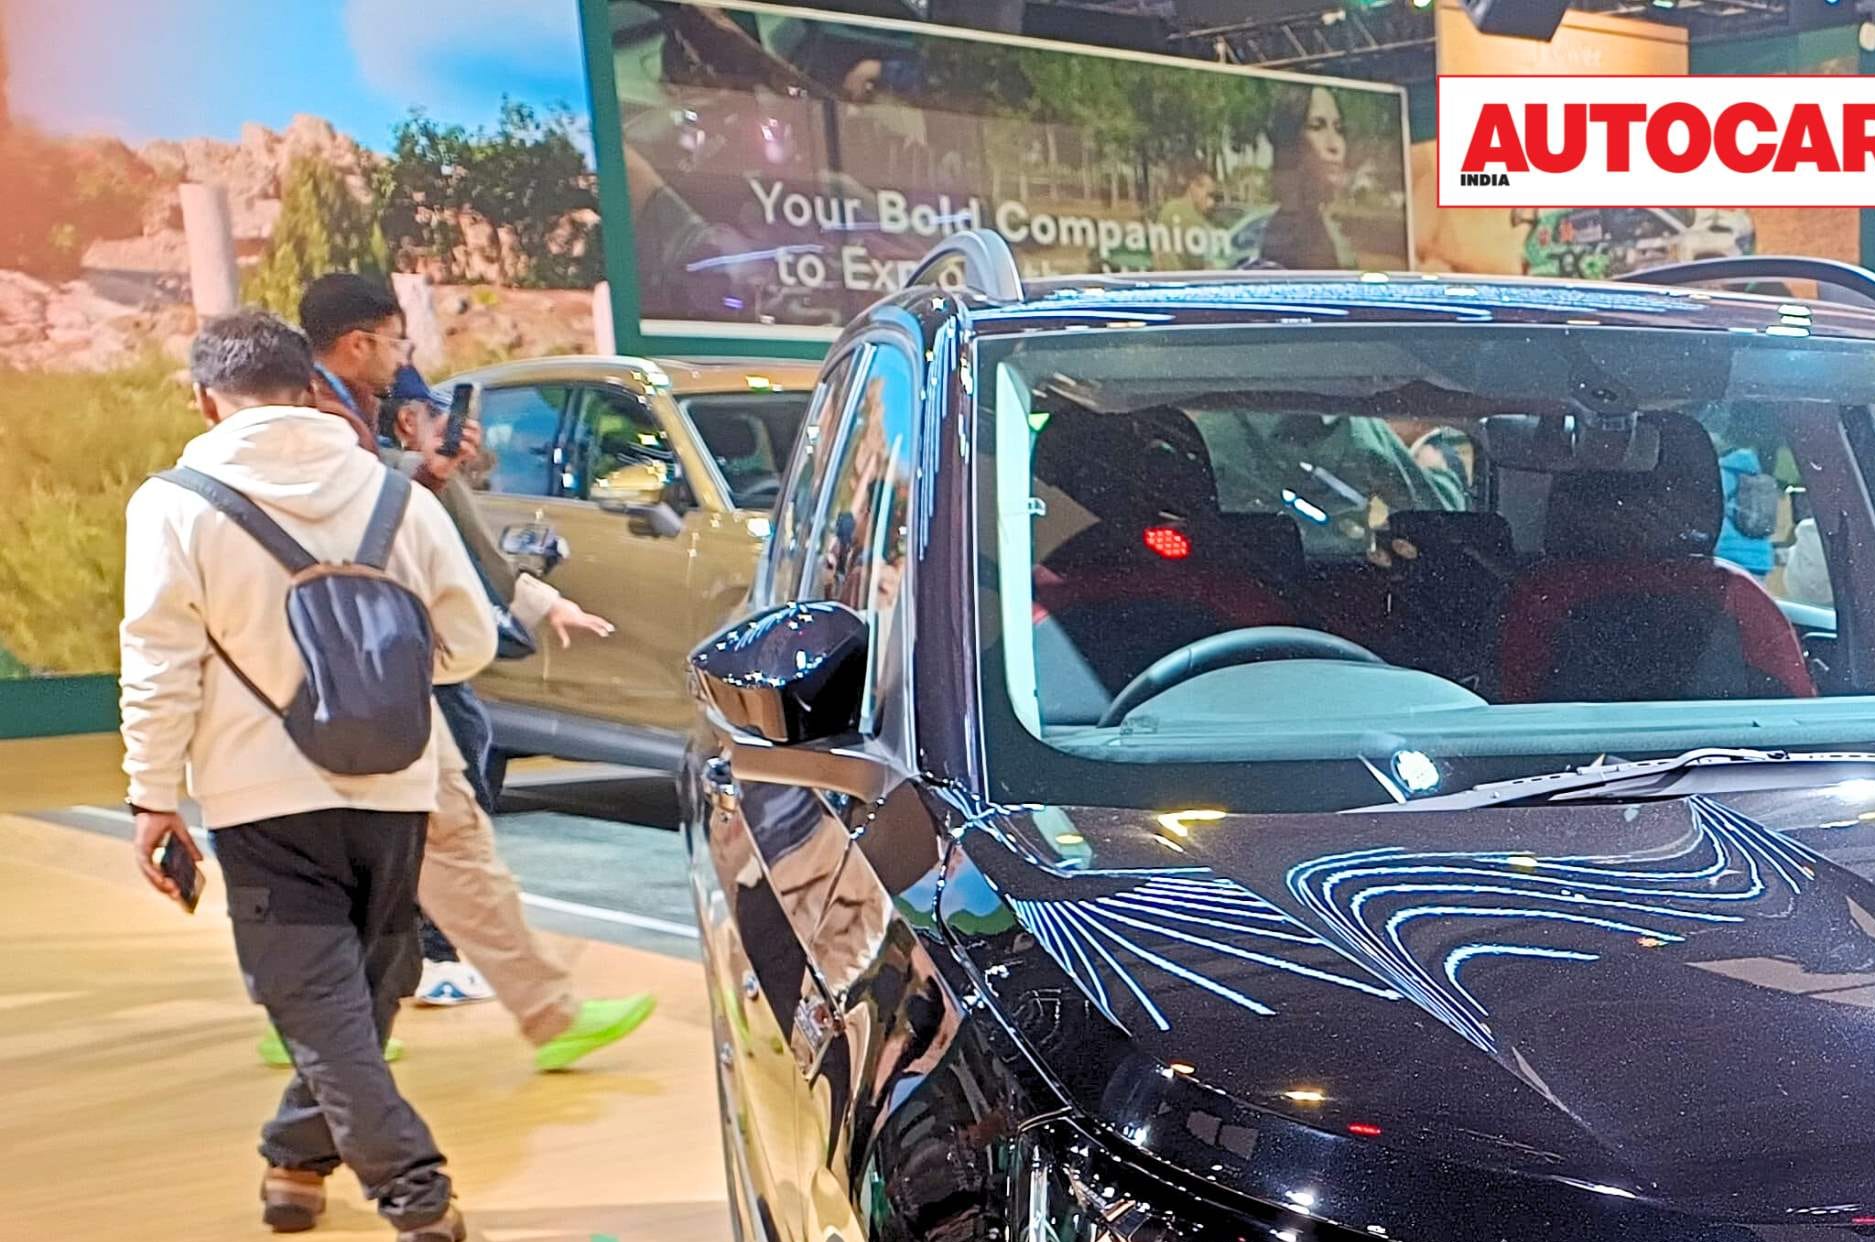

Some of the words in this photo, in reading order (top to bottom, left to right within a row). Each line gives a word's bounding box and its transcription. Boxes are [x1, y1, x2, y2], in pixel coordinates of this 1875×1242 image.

[749, 179, 860, 231] Your
[876, 189, 981, 237] Bold
[995, 199, 1234, 258] Companion
[774, 246, 828, 287] to
